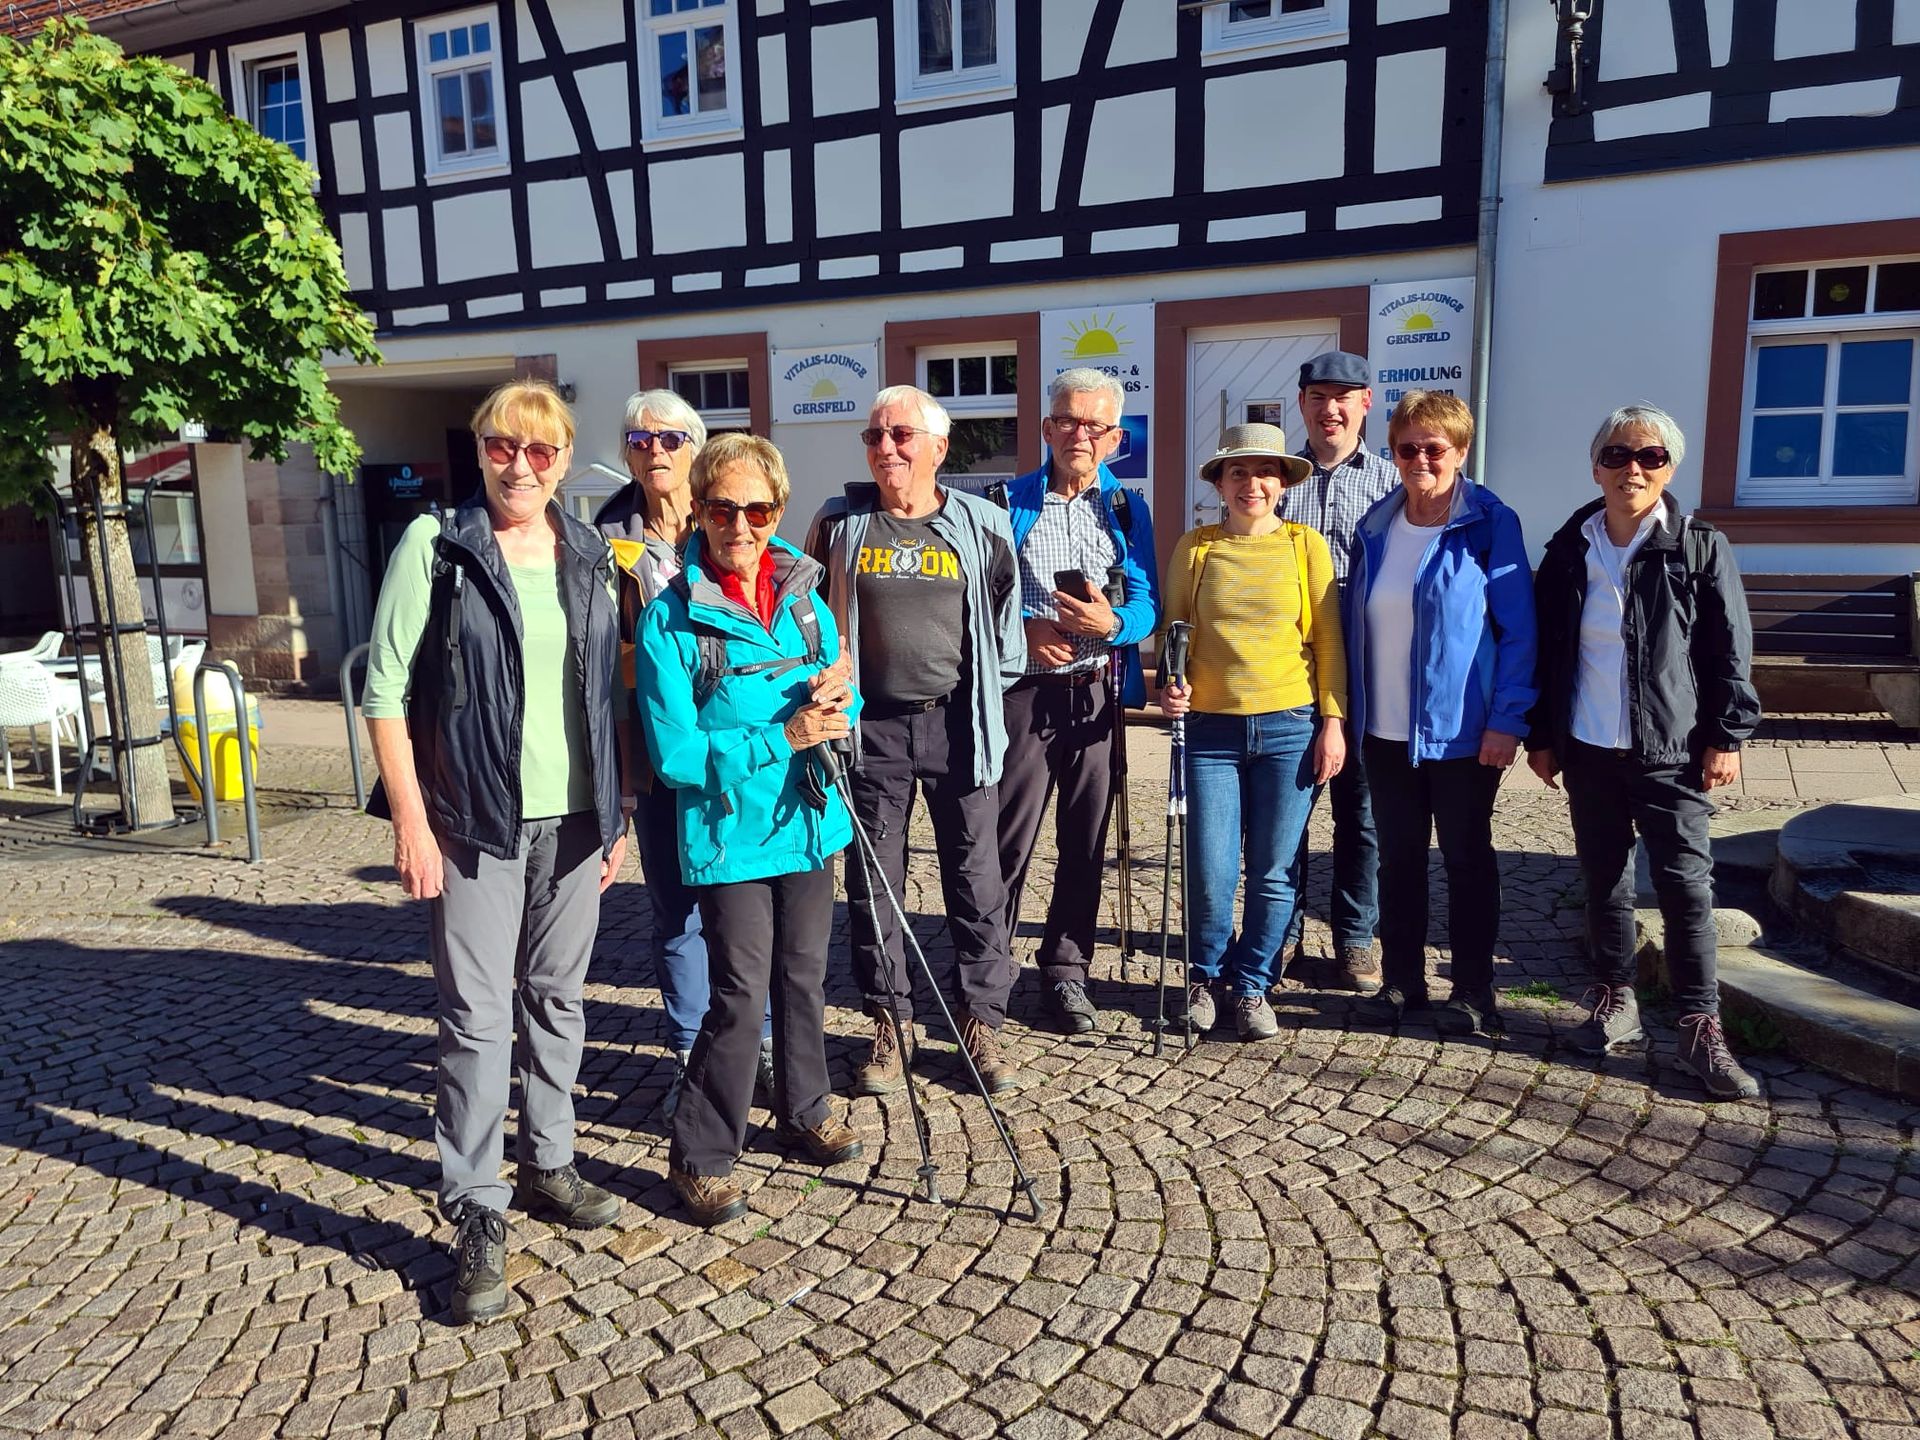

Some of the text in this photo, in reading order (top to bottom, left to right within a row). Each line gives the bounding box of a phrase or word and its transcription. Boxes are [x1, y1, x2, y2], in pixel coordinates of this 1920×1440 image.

[1379, 292, 1464, 317] VITALIS-LOUNGE
[1386, 331, 1450, 345] GERSFELD
[783, 354, 867, 382] VITALIS-LOUNGE
[1130, 364, 1140, 376] &
[1378, 365, 1462, 384] ERHOLUNG
[793, 400, 856, 415] GERSFELD
[857, 545, 959, 580] RHÖN
